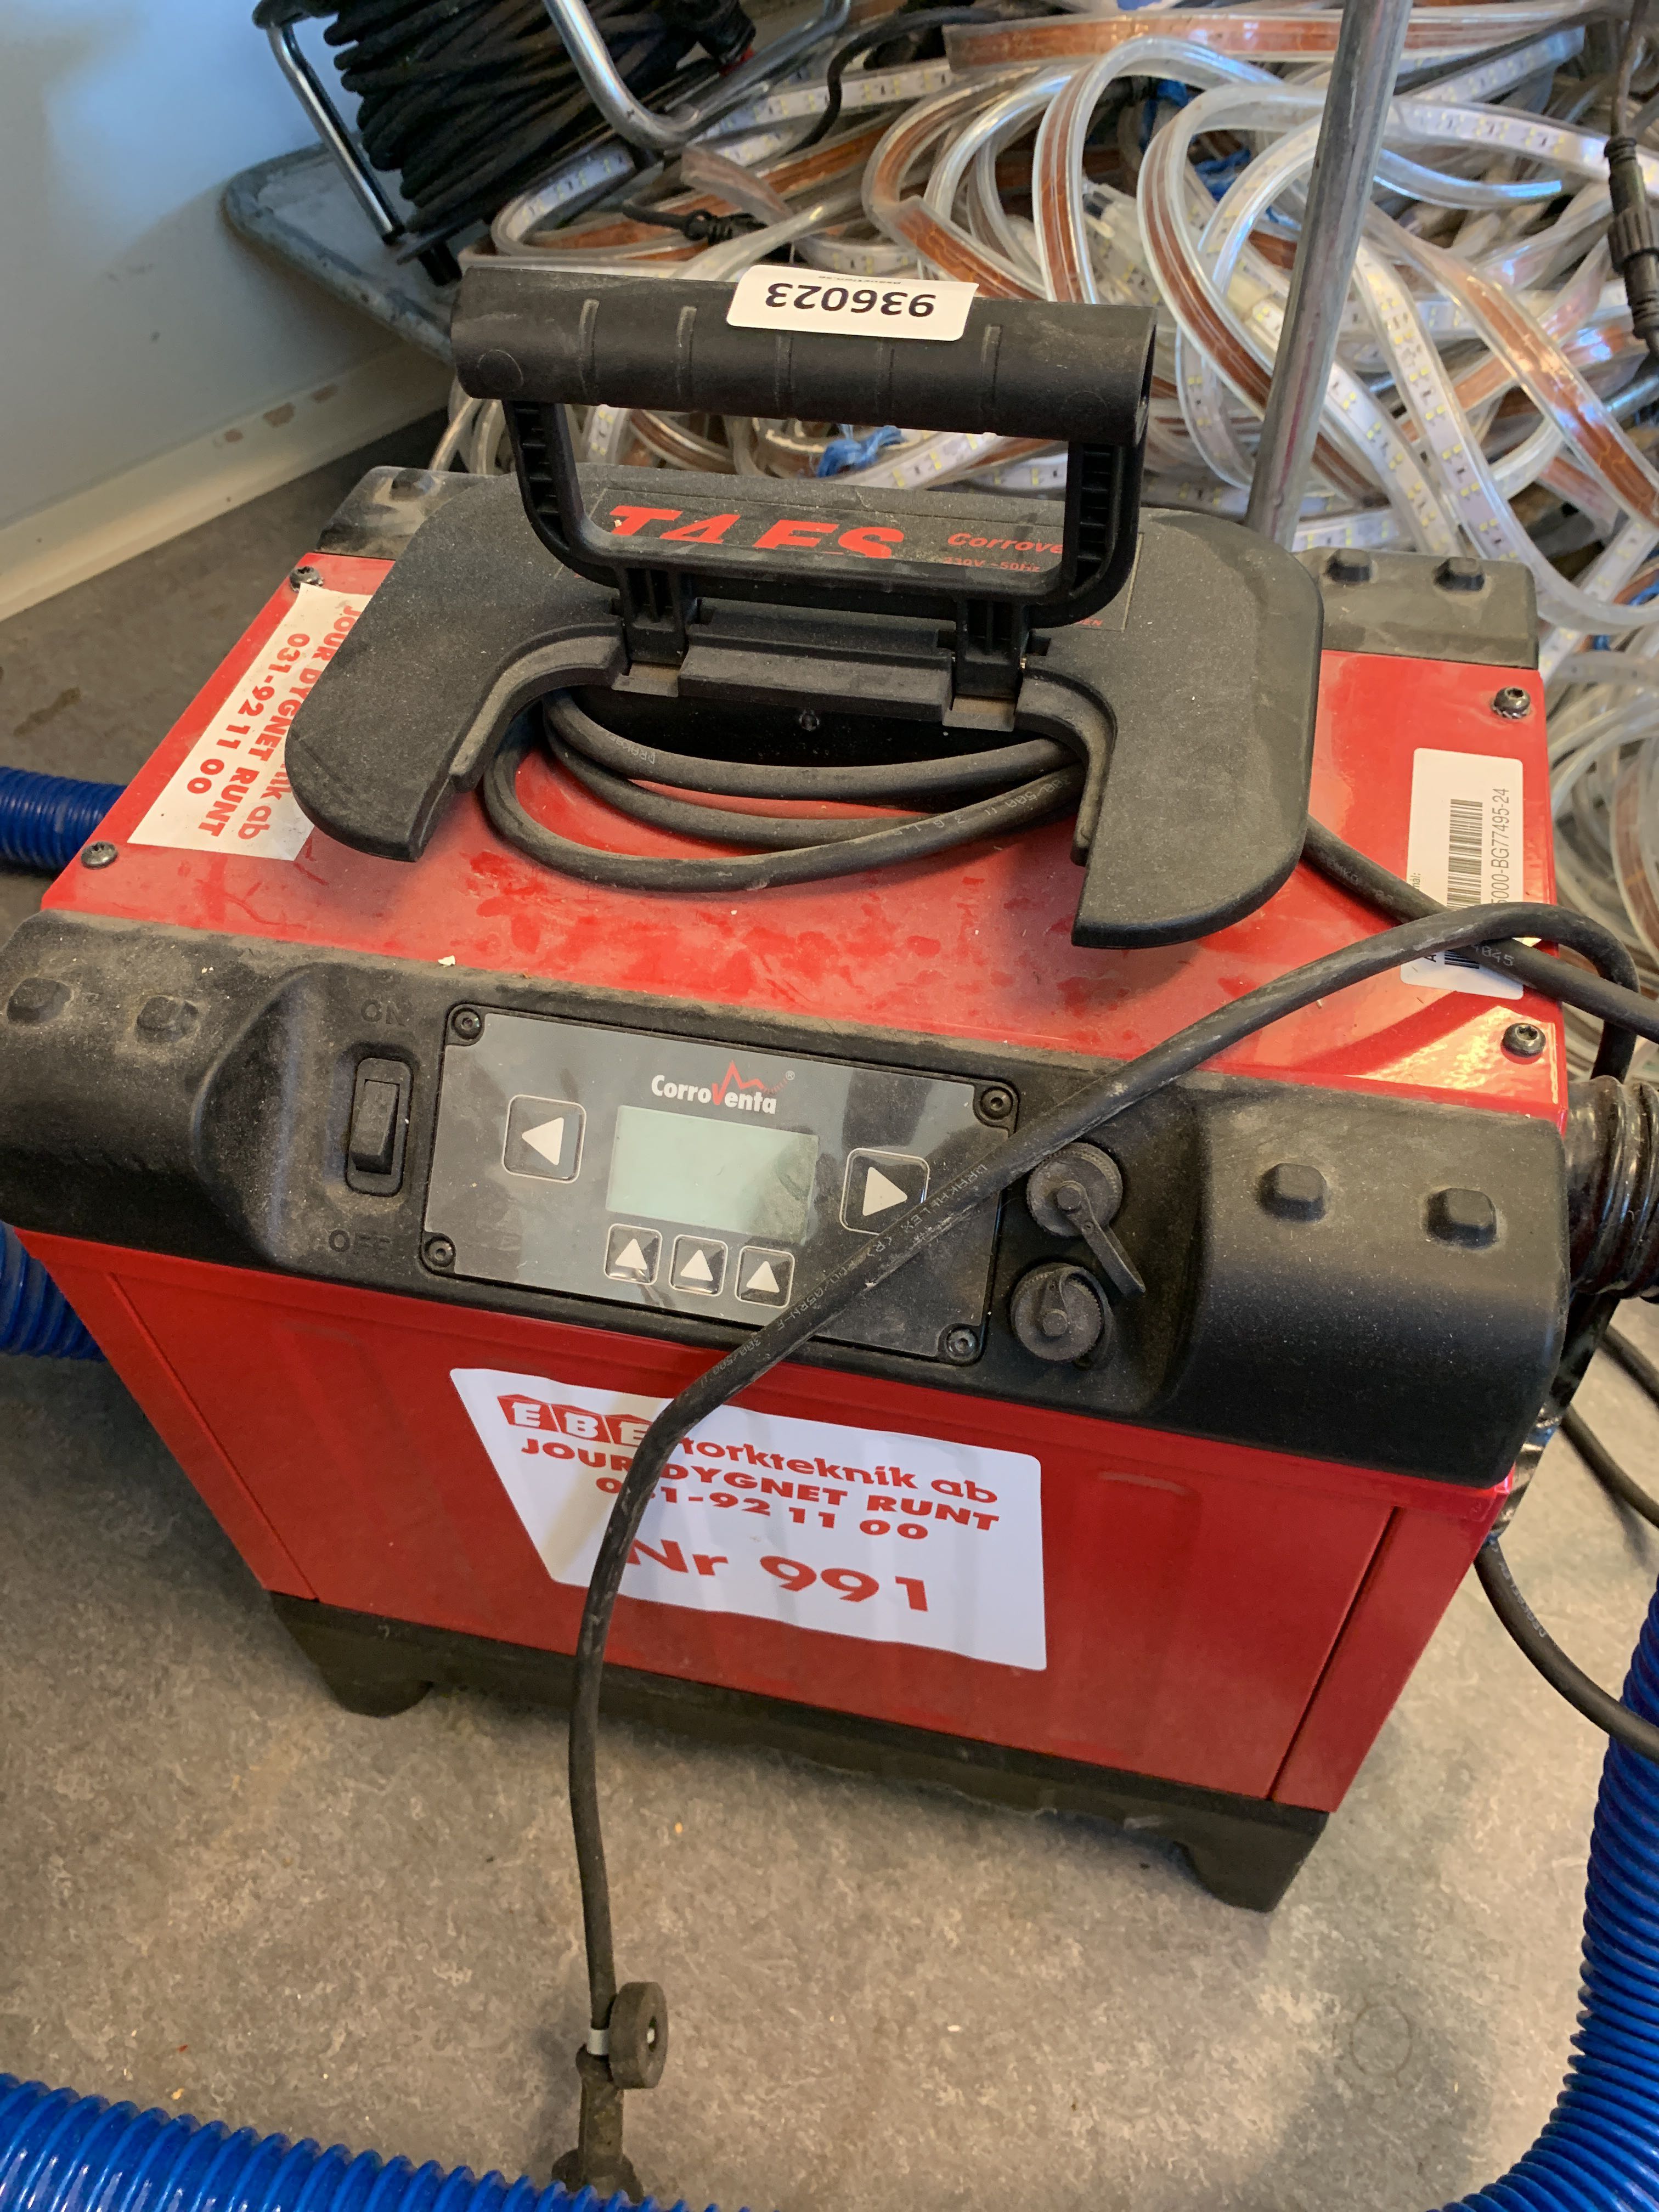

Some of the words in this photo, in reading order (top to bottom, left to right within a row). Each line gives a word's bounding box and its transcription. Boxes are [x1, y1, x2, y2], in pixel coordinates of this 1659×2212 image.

[765, 282, 936, 317] 936023
[610, 505, 741, 543] T4
[947, 532, 1064, 554] Corrove
[312, 605, 362, 661] JOUR
[238, 633, 311, 717] 031-92
[217, 724, 251, 749] 11
[248, 668, 324, 761] DYGNET
[187, 758, 225, 794] 00
[198, 767, 261, 837] RUNT
[238, 805, 272, 840] ab
[361, 998, 405, 1027] ON
[329, 1229, 391, 1253] OFF
[505, 1400, 651, 1447] EBE
[521, 1438, 630, 1471] JOUR
[662, 1463, 848, 1506] DYGNET
[867, 1494, 1000, 1531] RUNT
[678, 1436, 918, 1489] torkteknik
[931, 1479, 998, 1503] ab
[596, 1477, 771, 1516] 01-92
[789, 1506, 836, 1529] 11
[859, 1519, 928, 1539] 00
[626, 1538, 729, 1576] Nr
[760, 1555, 928, 1612] 991
